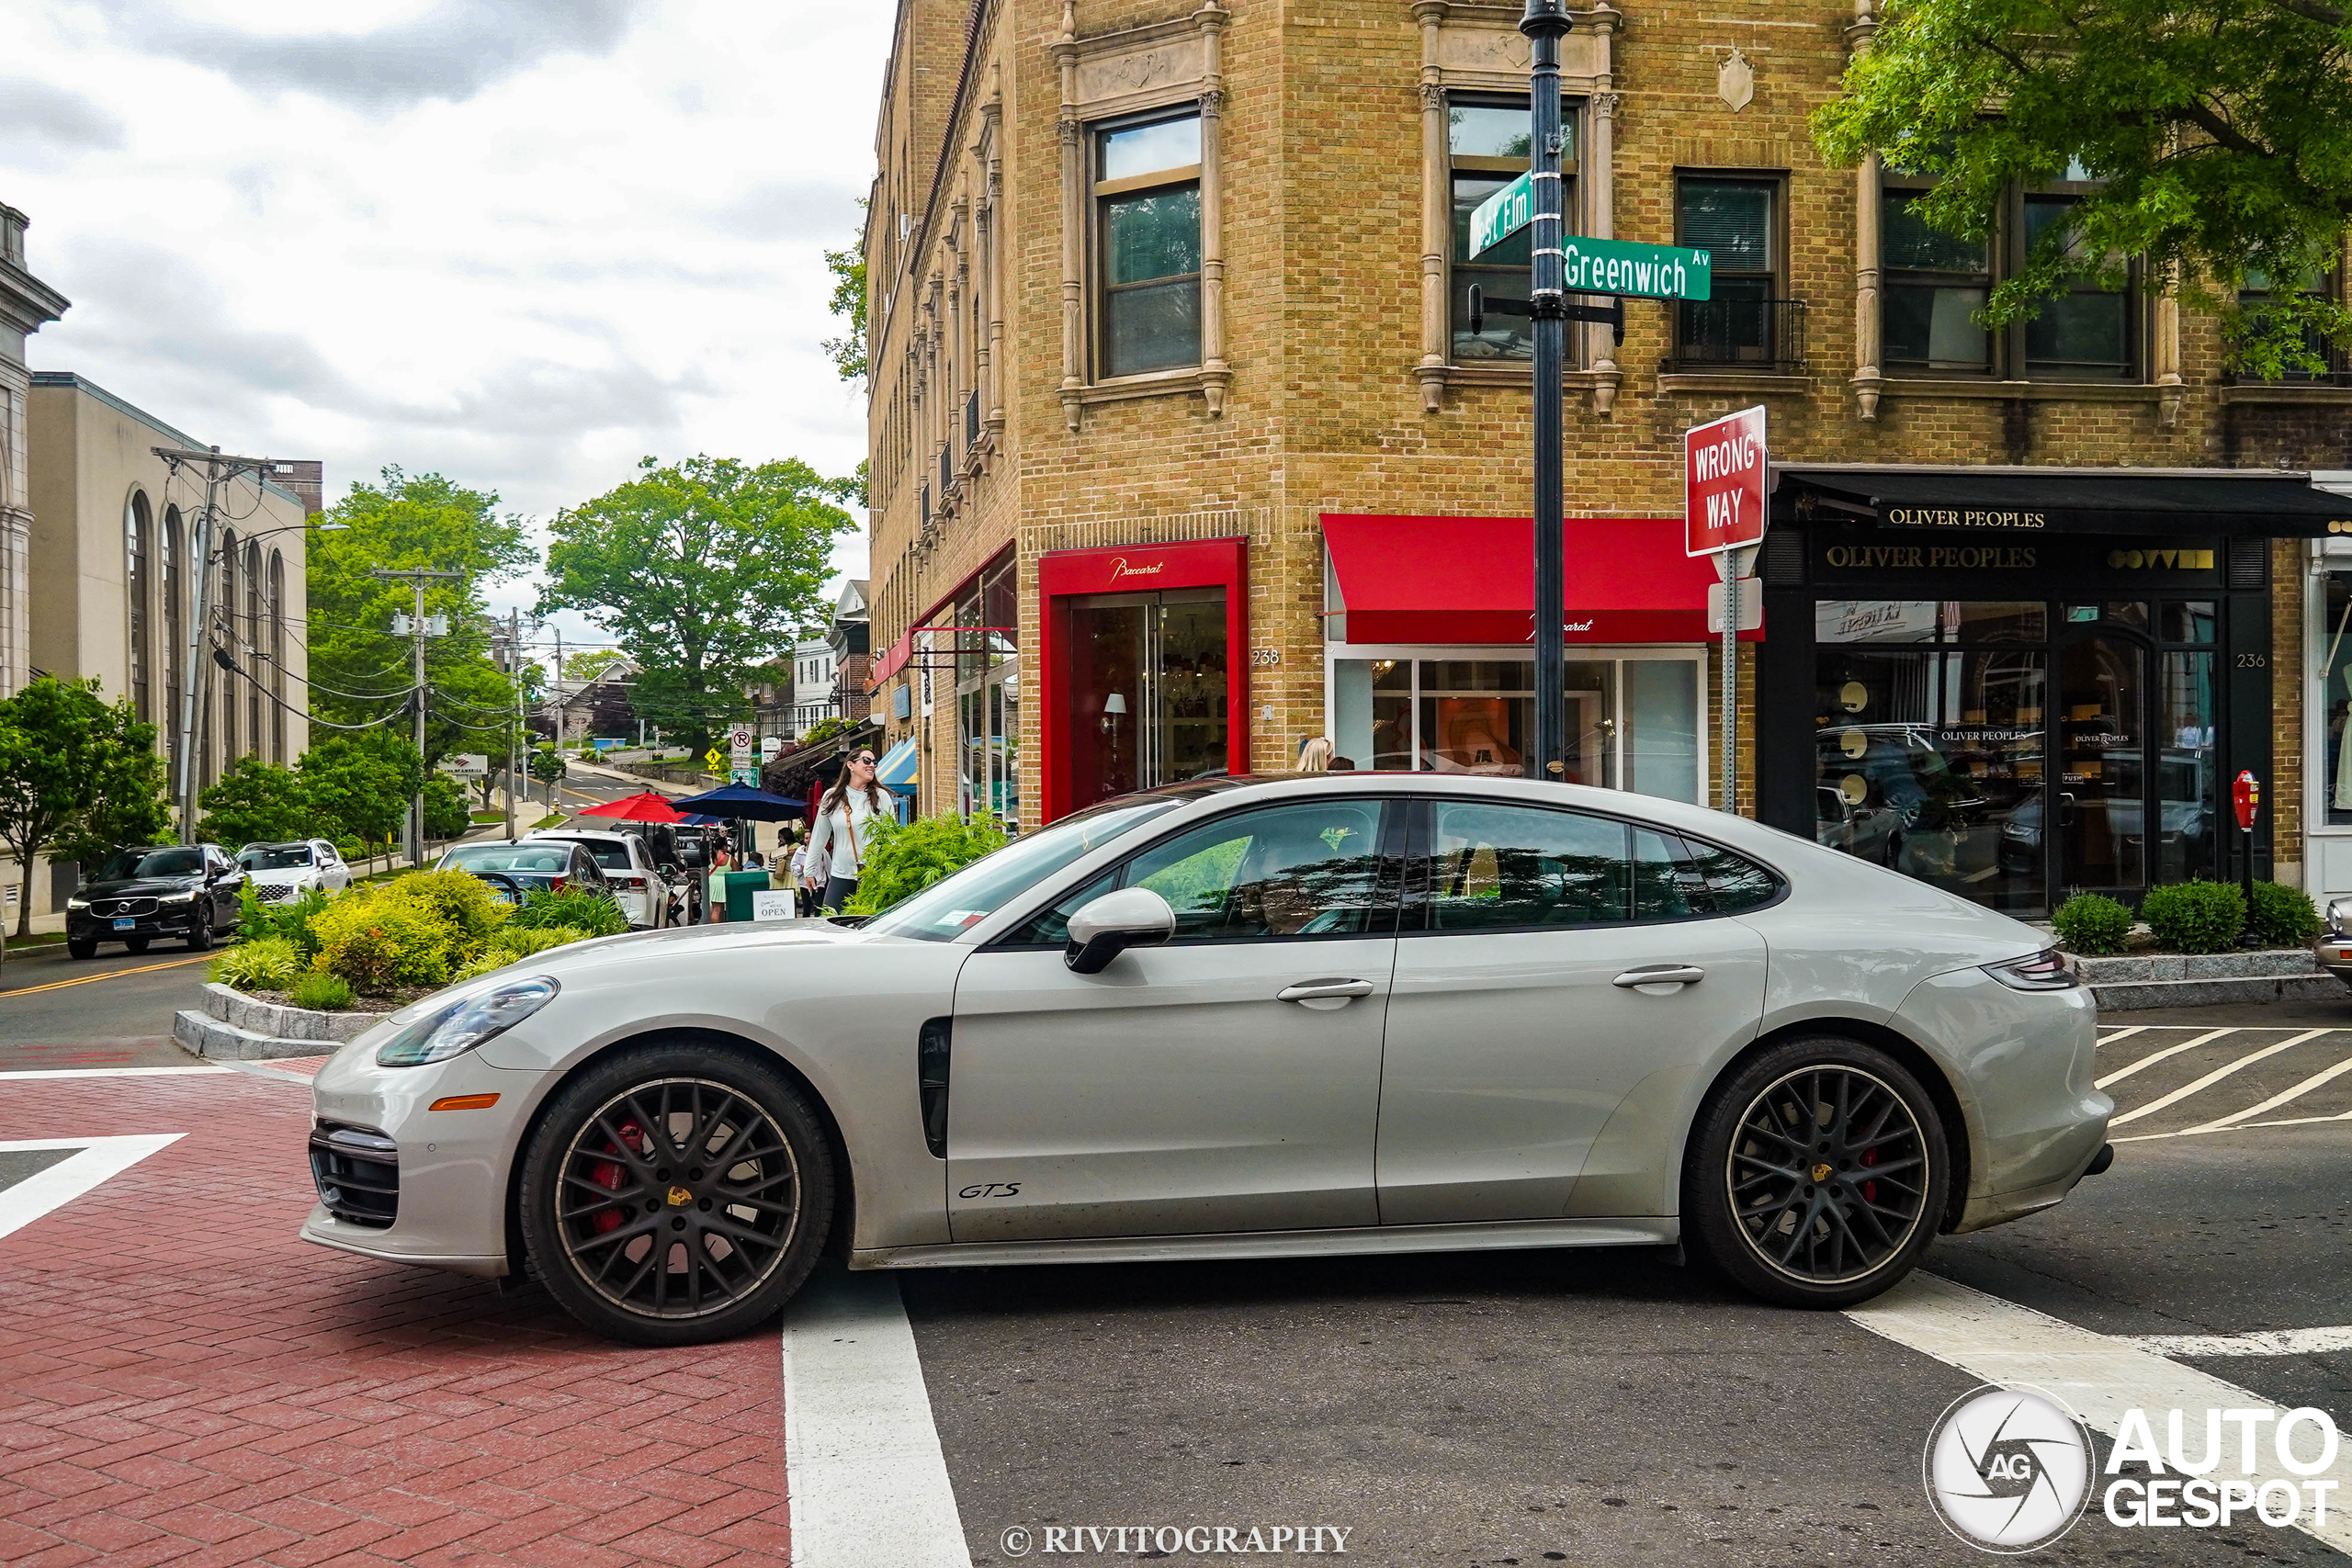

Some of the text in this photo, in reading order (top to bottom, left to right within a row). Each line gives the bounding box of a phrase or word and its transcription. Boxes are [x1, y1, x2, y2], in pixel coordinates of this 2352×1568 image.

[1504, 191, 1527, 235] Elm
[1565, 244, 1709, 297] Greenwich Av
[1695, 433, 1755, 483] WRONG
[1706, 487, 1744, 530] WAY
[1889, 509, 2045, 528] OLIVER PEOPLES
[1826, 546, 2036, 569] OLIVER PEOPLES
[1109, 557, 1164, 584] Baccarat
[1526, 613, 1593, 640] carat
[1252, 649, 1280, 665] 238
[2236, 653, 2266, 668] 236
[1941, 730, 2027, 740] OLIVER PEOPLES
[761, 908, 786, 917] OPEN
[958, 1182, 1022, 1199] GTS
